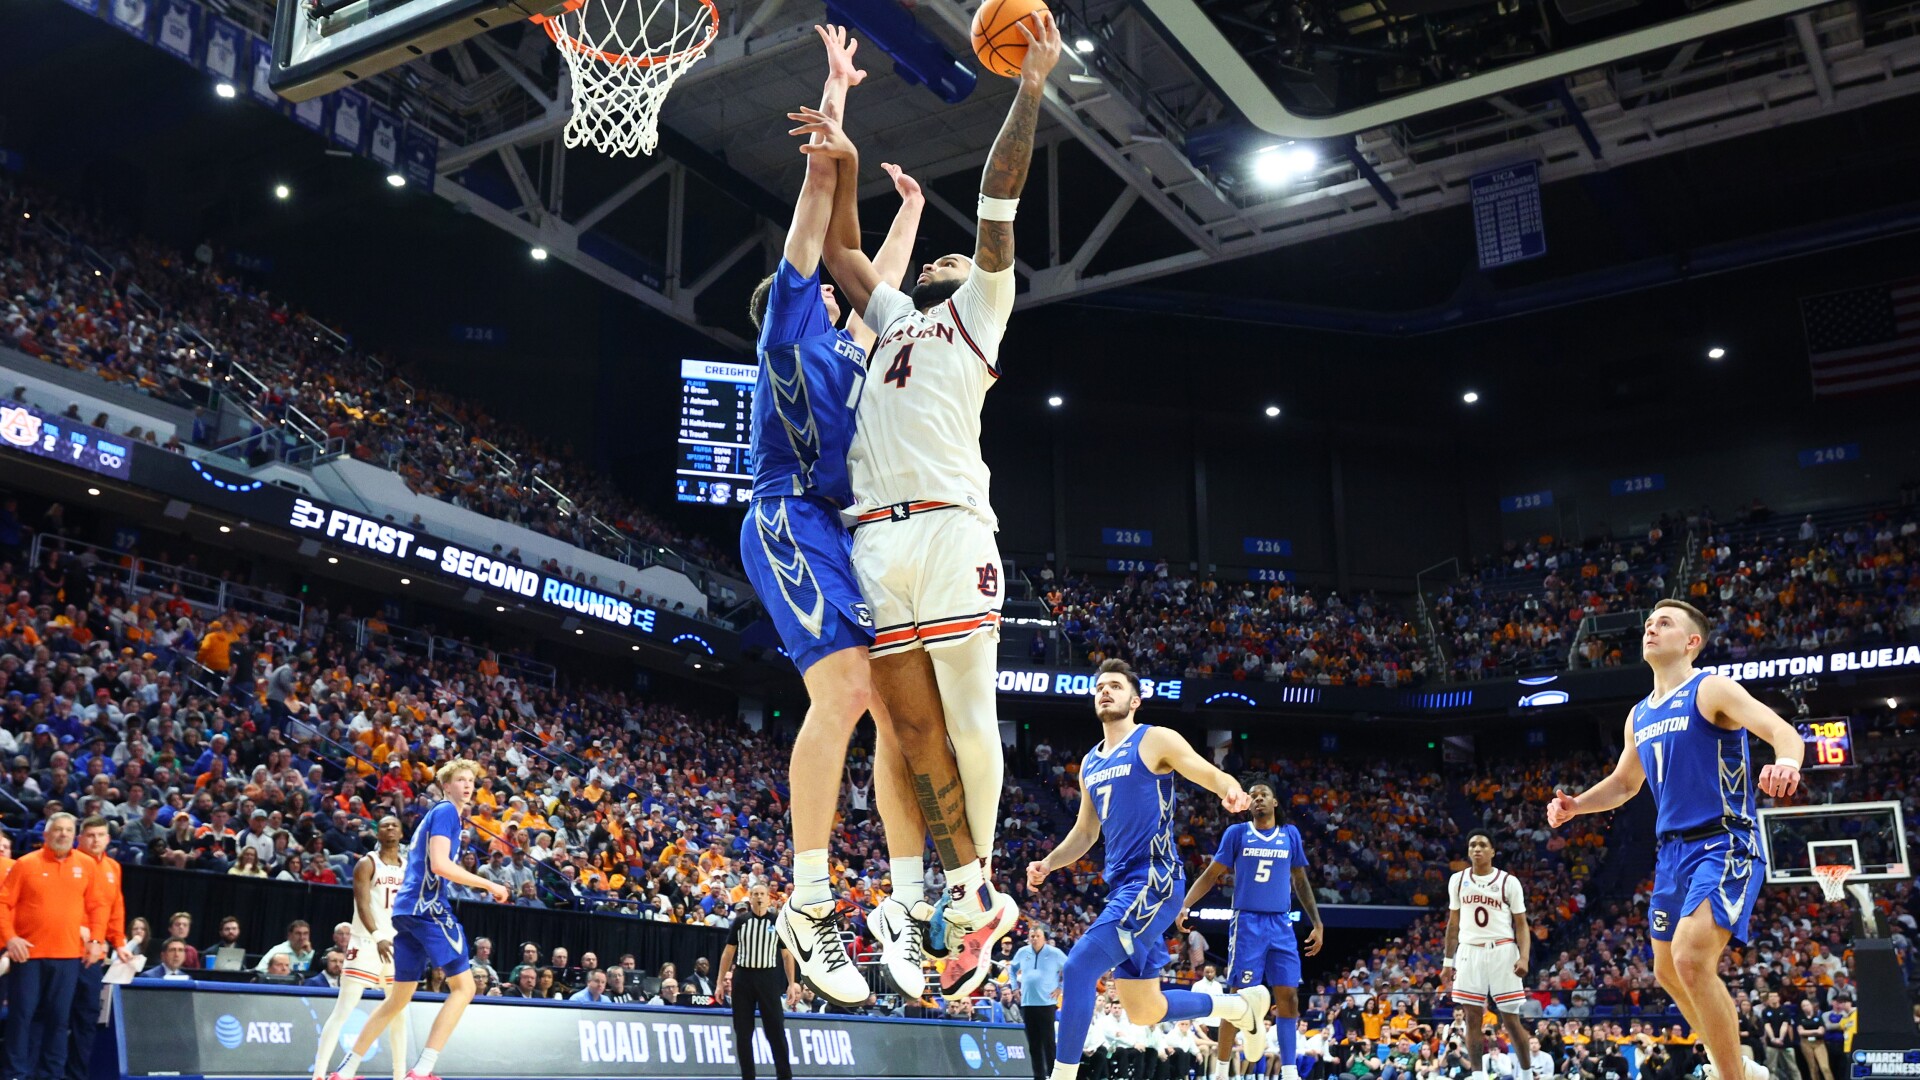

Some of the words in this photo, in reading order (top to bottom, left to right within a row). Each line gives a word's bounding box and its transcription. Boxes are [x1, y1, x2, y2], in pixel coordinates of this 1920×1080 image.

[1492, 170, 1516, 183] UCA
[705, 365, 757, 378] CREIGHTO
[884, 342, 914, 389] 4
[690, 386, 709, 394] Green
[683, 396, 688, 404] 1
[690, 397, 719, 406] Ashworth
[681, 418, 688, 426] 11
[689, 419, 726, 429] Kalkbrenner
[43, 434, 57, 452] 2
[72, 443, 84, 460] 7
[71, 431, 88, 446] FLS
[97, 440, 126, 458] BONUS
[1815, 446, 1846, 463] 240
[1625, 476, 1652, 492] 238
[736, 489, 754, 502] 54
[1515, 494, 1541, 510] 238
[1116, 530, 1141, 544] 236
[1256, 540, 1281, 553] 236
[326, 509, 415, 559] FIRST
[415, 546, 437, 561] AND
[440, 546, 540, 598] SECOND
[542, 577, 633, 626] ROUNDS
[1118, 559, 1145, 572] 236
[1259, 568, 1286, 582] 236
[1694, 654, 1824, 681] EIGHTON
[1830, 645, 1920, 672] BLUEJA
[996, 670, 1050, 693] OND
[1810, 721, 1846, 738] 7:00
[1816, 738, 1845, 764] 16
[1651, 741, 1663, 783] 1
[1096, 784, 1112, 819] 7
[1242, 847, 1289, 859] CREIGHTON
[1254, 859, 1273, 883] 5
[1462, 894, 1502, 911] AUBURN
[1474, 906, 1489, 928] 0
[691, 995, 710, 1006] POSS
[246, 1021, 293, 1044] AT&T
[578, 1019, 650, 1063] ROAD
[652, 1022, 687, 1064] TO
[688, 1024, 736, 1064] THE
[751, 1027, 799, 1065] INL
[799, 1028, 855, 1066] FOUR
[1006, 1045, 1026, 1059] AT&T
[1865, 1052, 1904, 1063] MARCH
[1871, 1062, 1920, 1074] MADNESS
